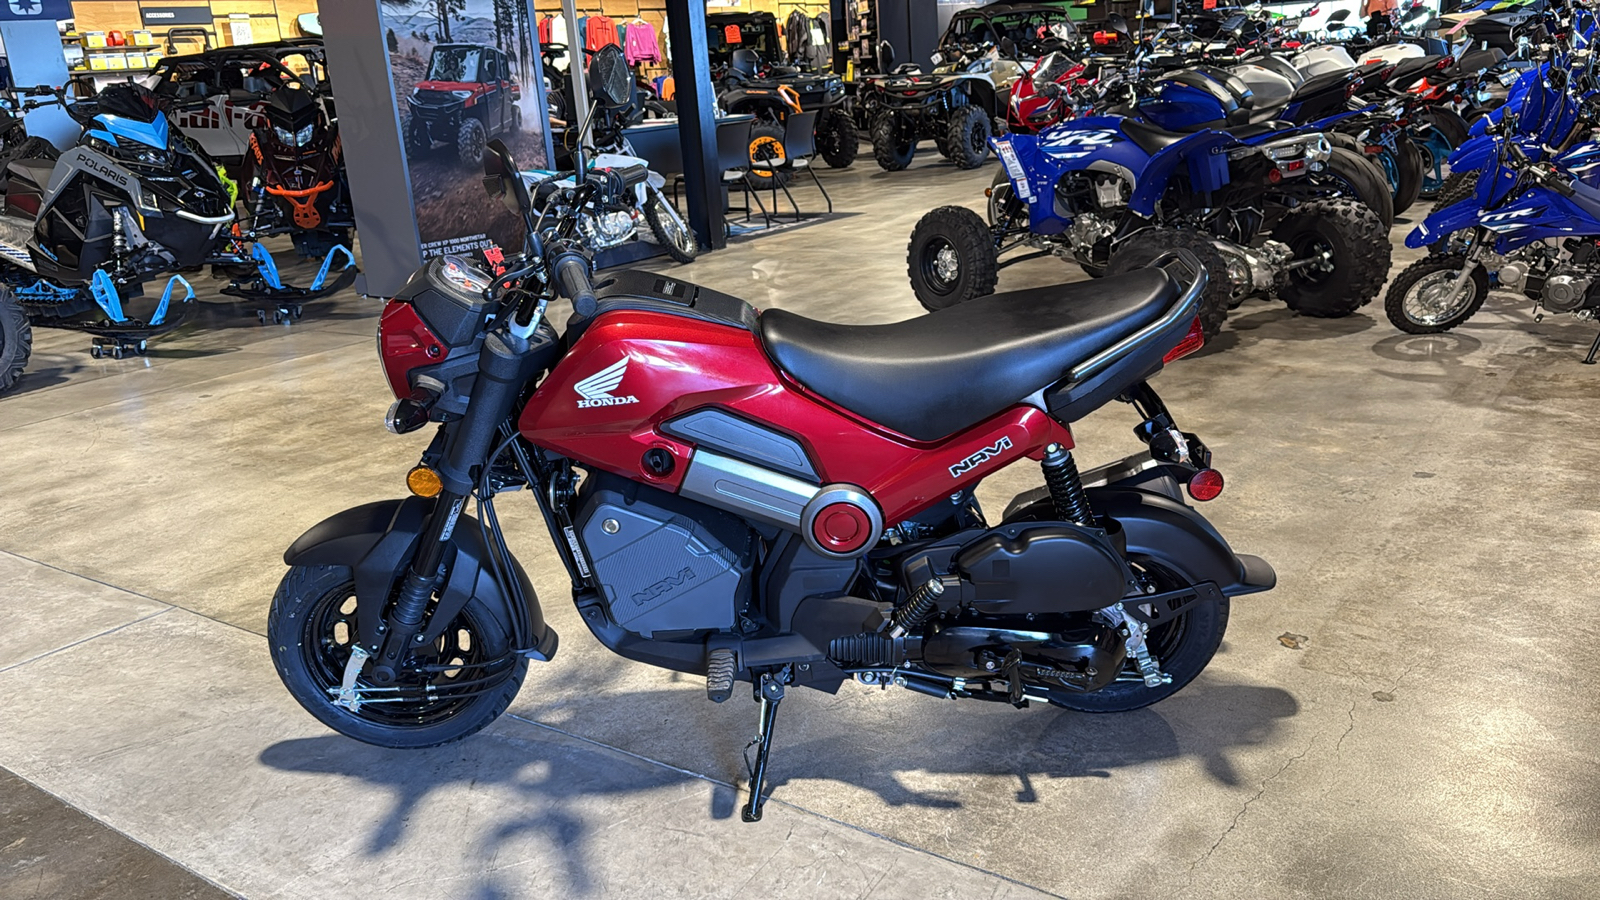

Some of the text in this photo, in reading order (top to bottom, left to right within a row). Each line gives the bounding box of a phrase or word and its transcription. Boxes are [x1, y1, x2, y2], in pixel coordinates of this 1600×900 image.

[76, 153, 129, 187] POLARIS
[428, 240, 442, 248] CREW
[429, 247, 443, 257] THE
[443, 241, 479, 255] ELEMENTS
[576, 395, 640, 409] HONDA
